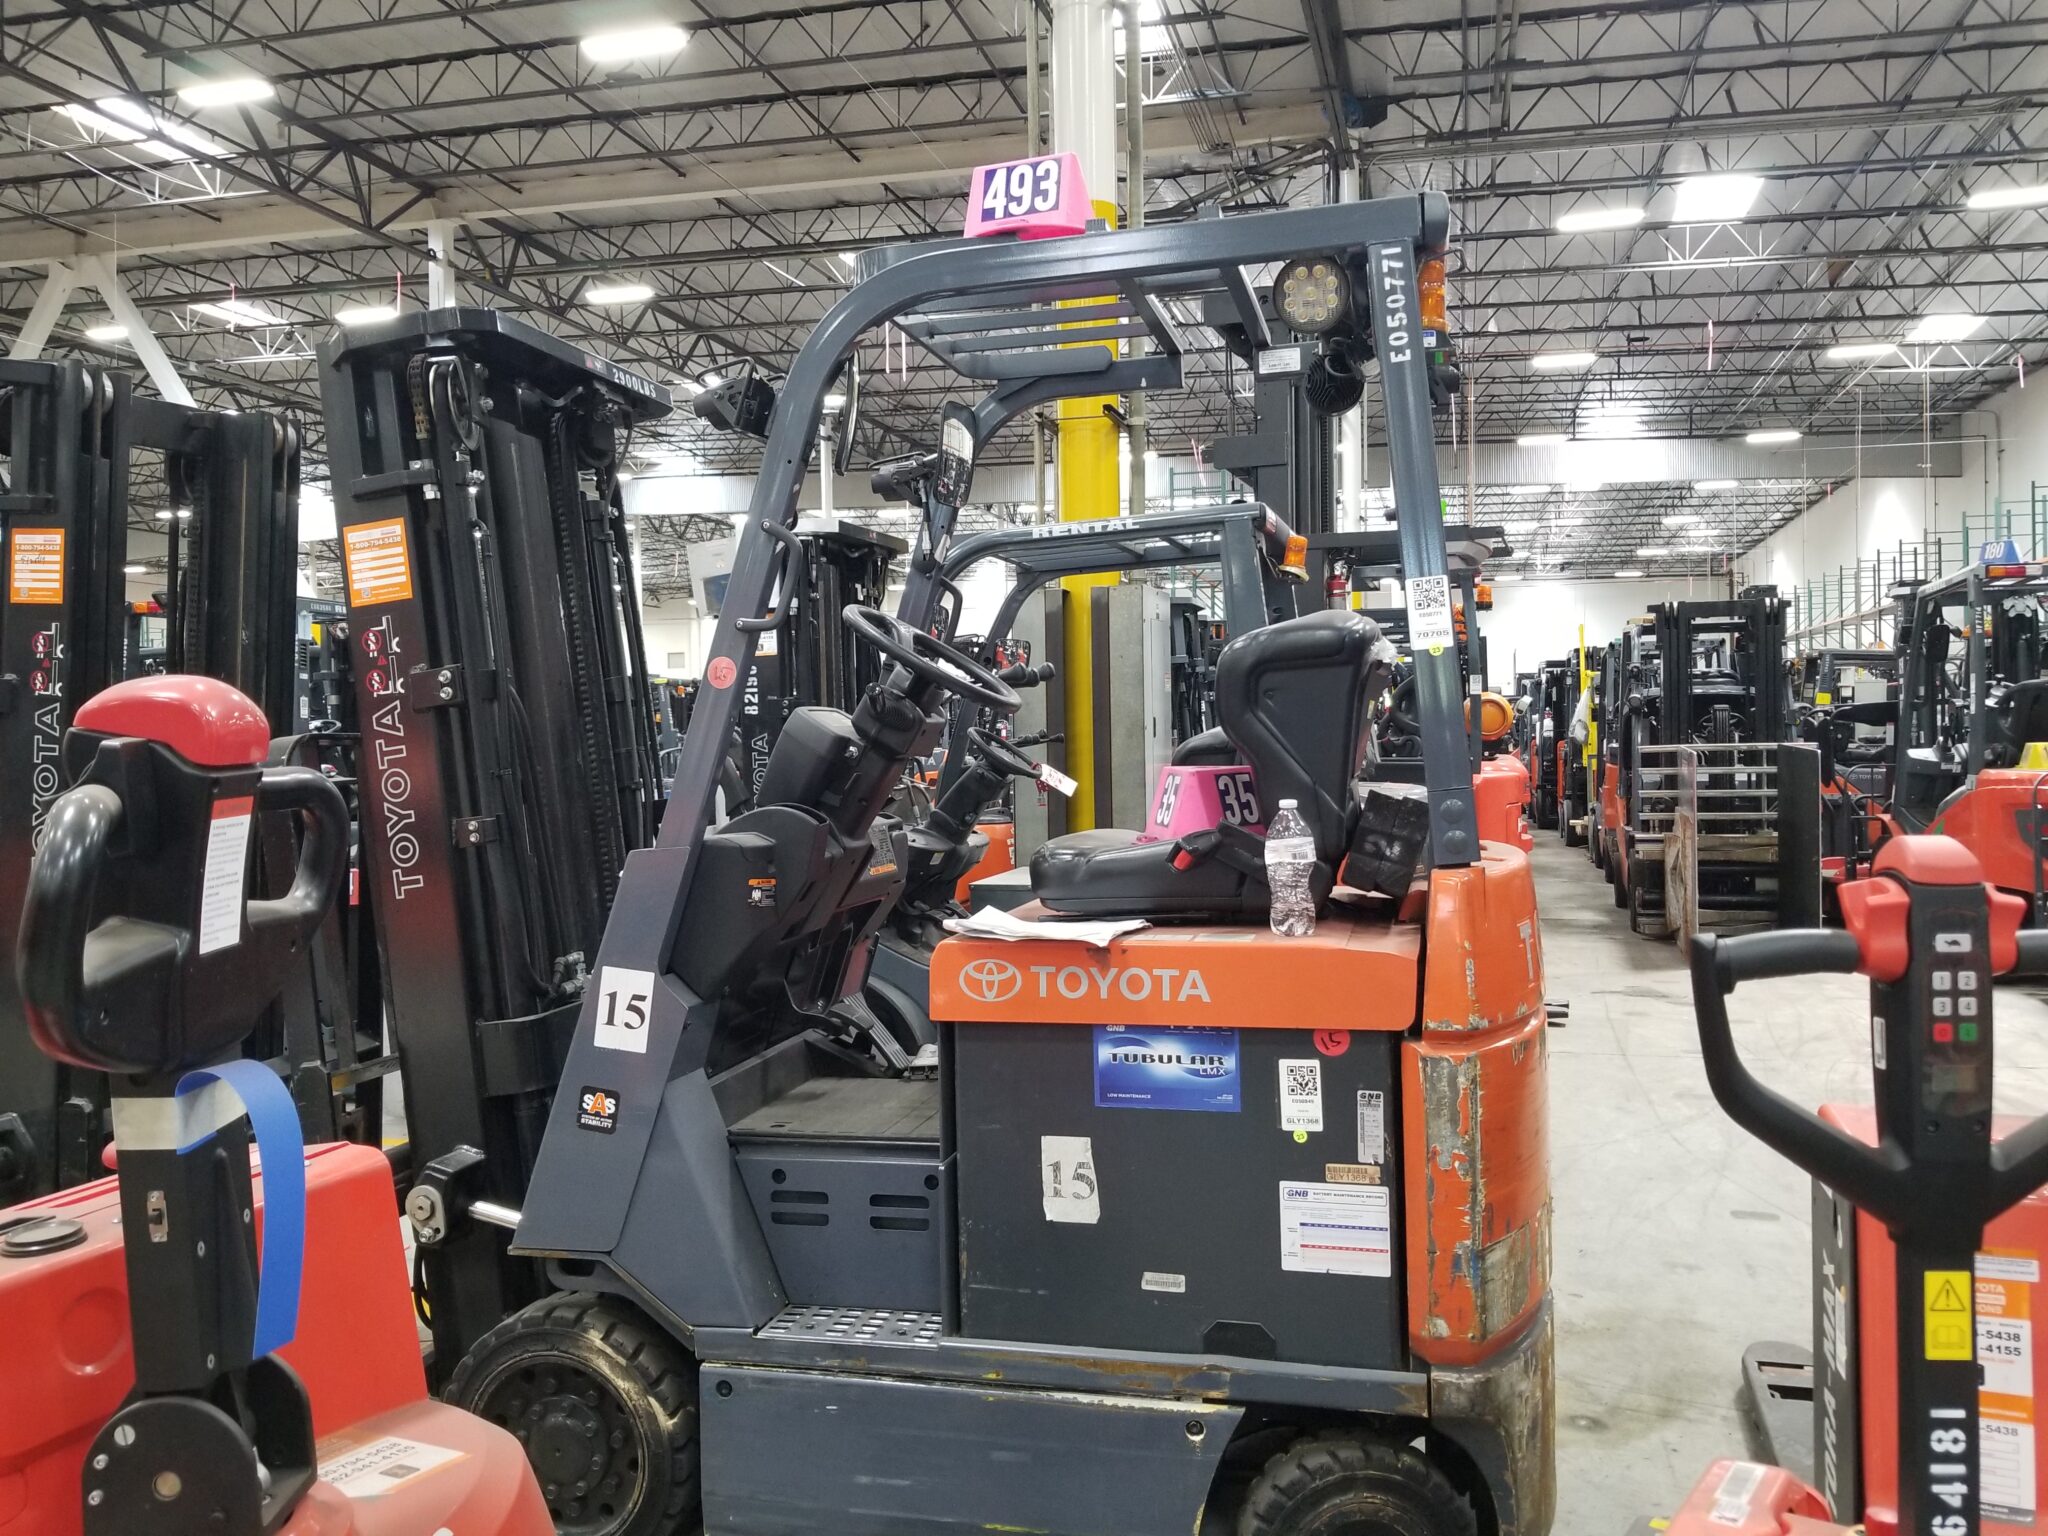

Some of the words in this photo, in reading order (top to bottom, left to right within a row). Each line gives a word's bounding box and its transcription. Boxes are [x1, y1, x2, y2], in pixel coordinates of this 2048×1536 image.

[983, 159, 1059, 219] 493
[1381, 246, 1411, 363] E050771
[612, 367, 657, 398] 2900LBS
[1032, 518, 1140, 539] RENTAL
[1984, 542, 2005, 559] 180
[1416, 629, 1449, 639] 70705
[31, 702, 61, 872] YOTA
[372, 699, 424, 900] TOYOTA
[1156, 774, 1182, 826] 35
[1217, 774, 1259, 826] 35
[1030, 965, 1211, 1003] TOYOTA
[602, 991, 648, 1030] 15
[1106, 1024, 1125, 1032] GNB
[1108, 1053, 1225, 1066] TUBULAR
[1199, 1067, 1226, 1076] LMX
[582, 1092, 617, 1117] SAS
[580, 1118, 613, 1129] STABILITY
[1046, 1160, 1096, 1200] 15
[1287, 1189, 1309, 1198] GNB
